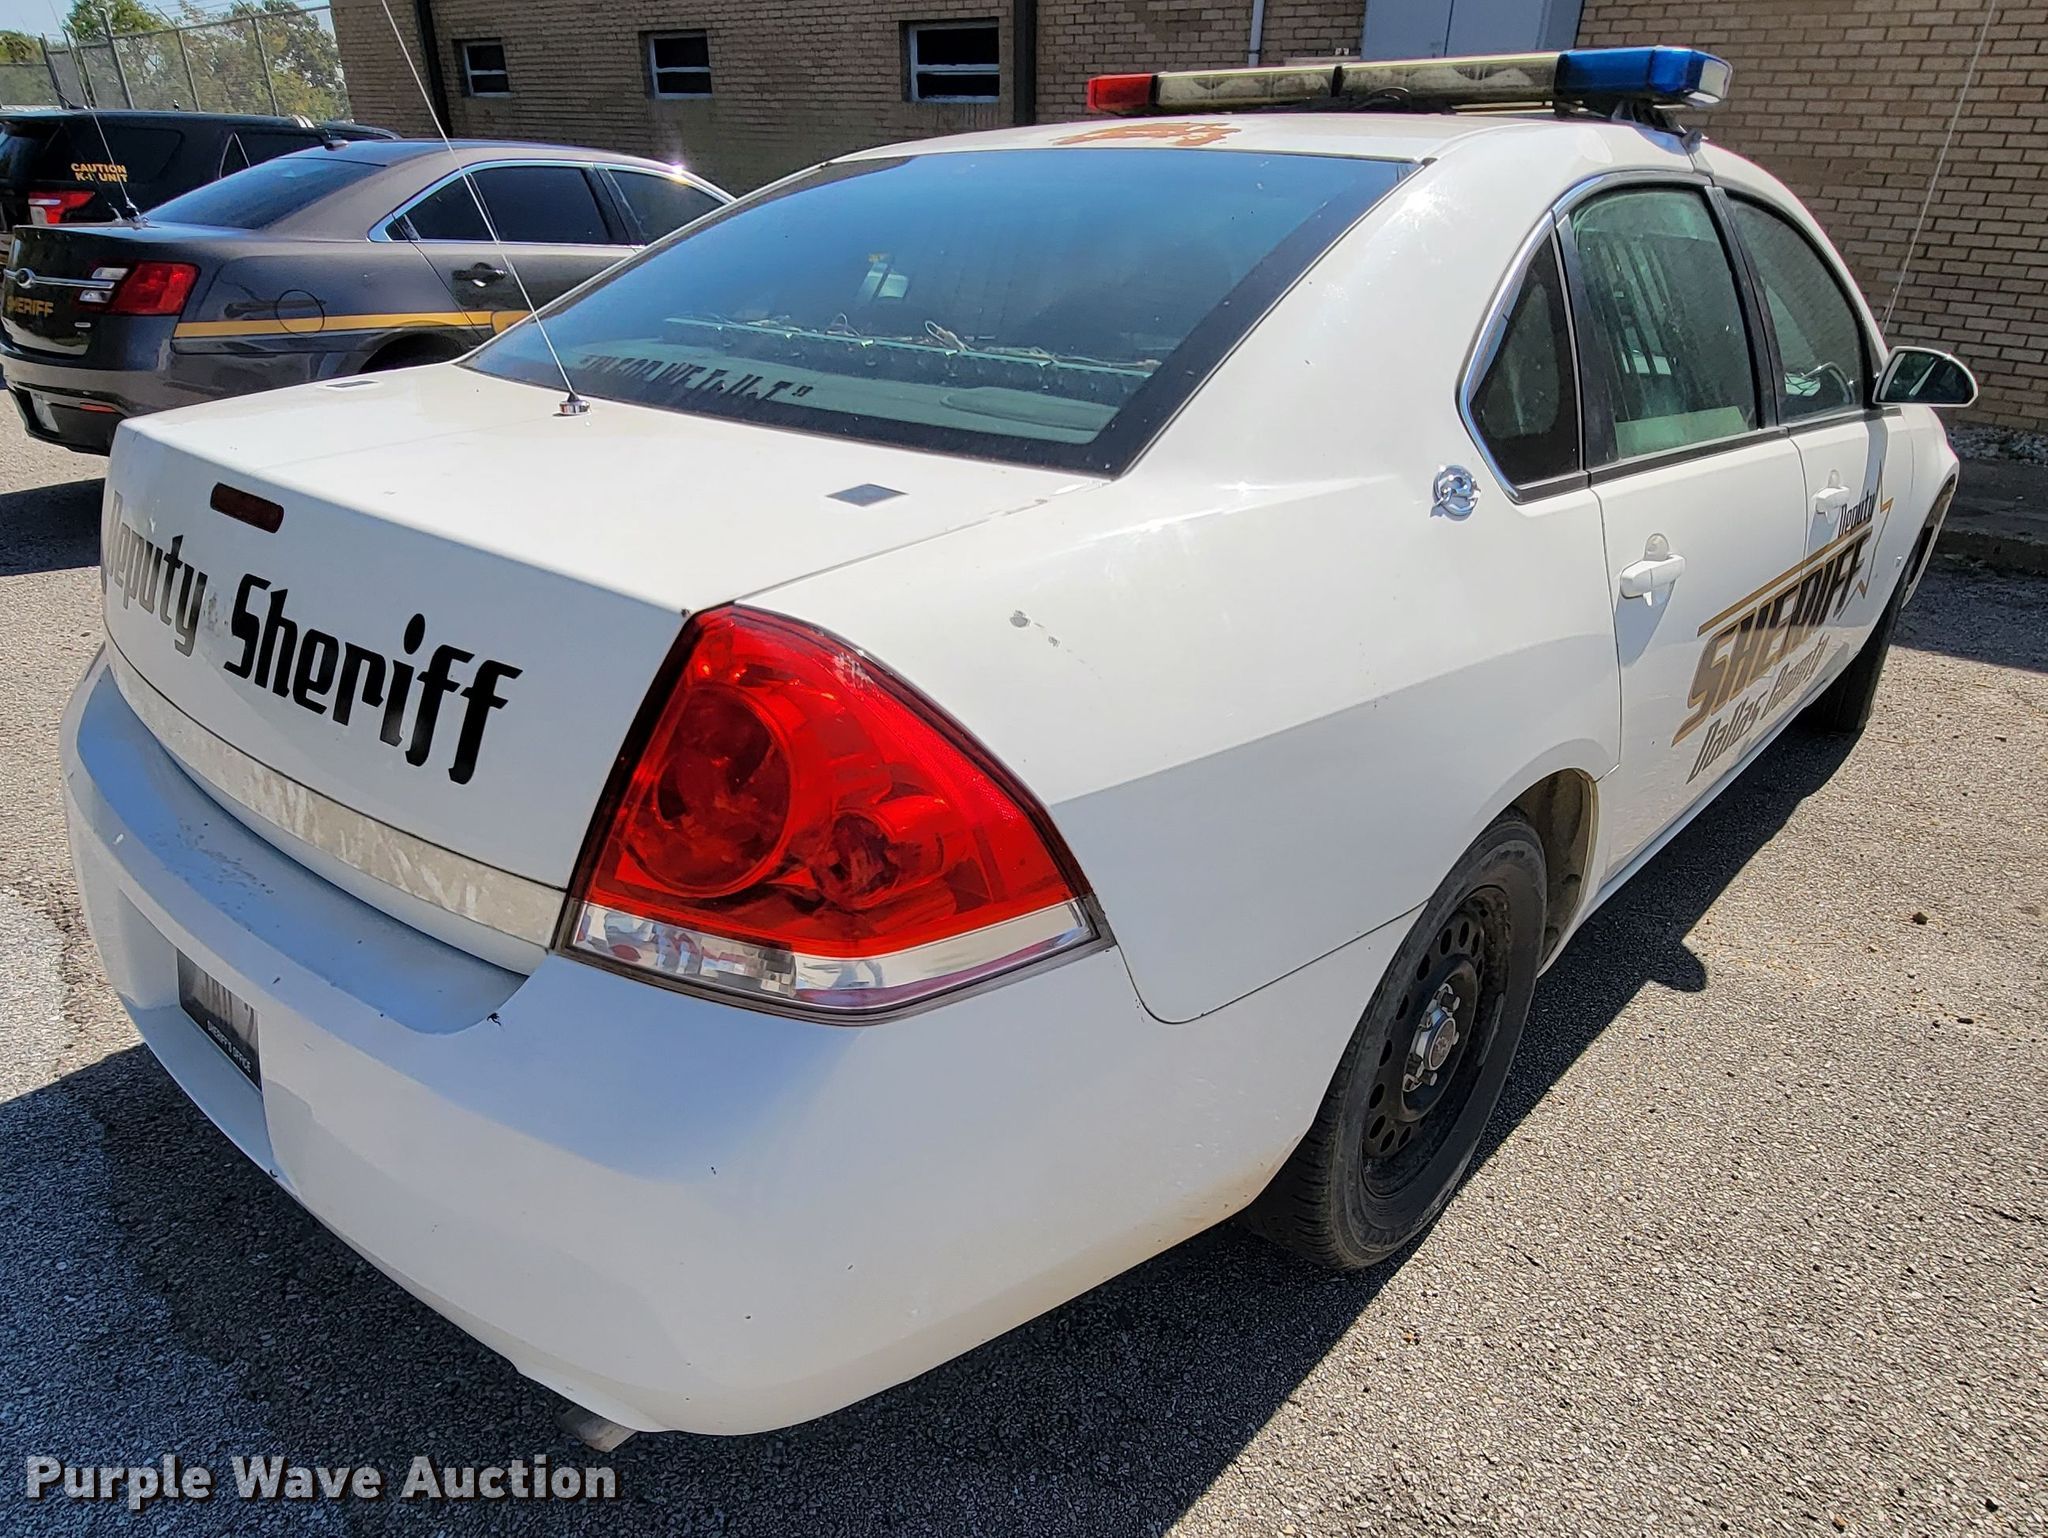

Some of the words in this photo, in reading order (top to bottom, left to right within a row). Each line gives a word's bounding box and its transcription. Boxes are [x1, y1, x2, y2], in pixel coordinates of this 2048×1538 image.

[70, 162, 127, 174] CAUTION
[98, 173, 128, 183] UNIT
[1838, 489, 1876, 539] Deputy
[105, 490, 208, 657] Deputy
[223, 573, 523, 784] Sheriff
[1671, 525, 1873, 747] SHERIFF
[1686, 690, 1769, 784] Dallas
